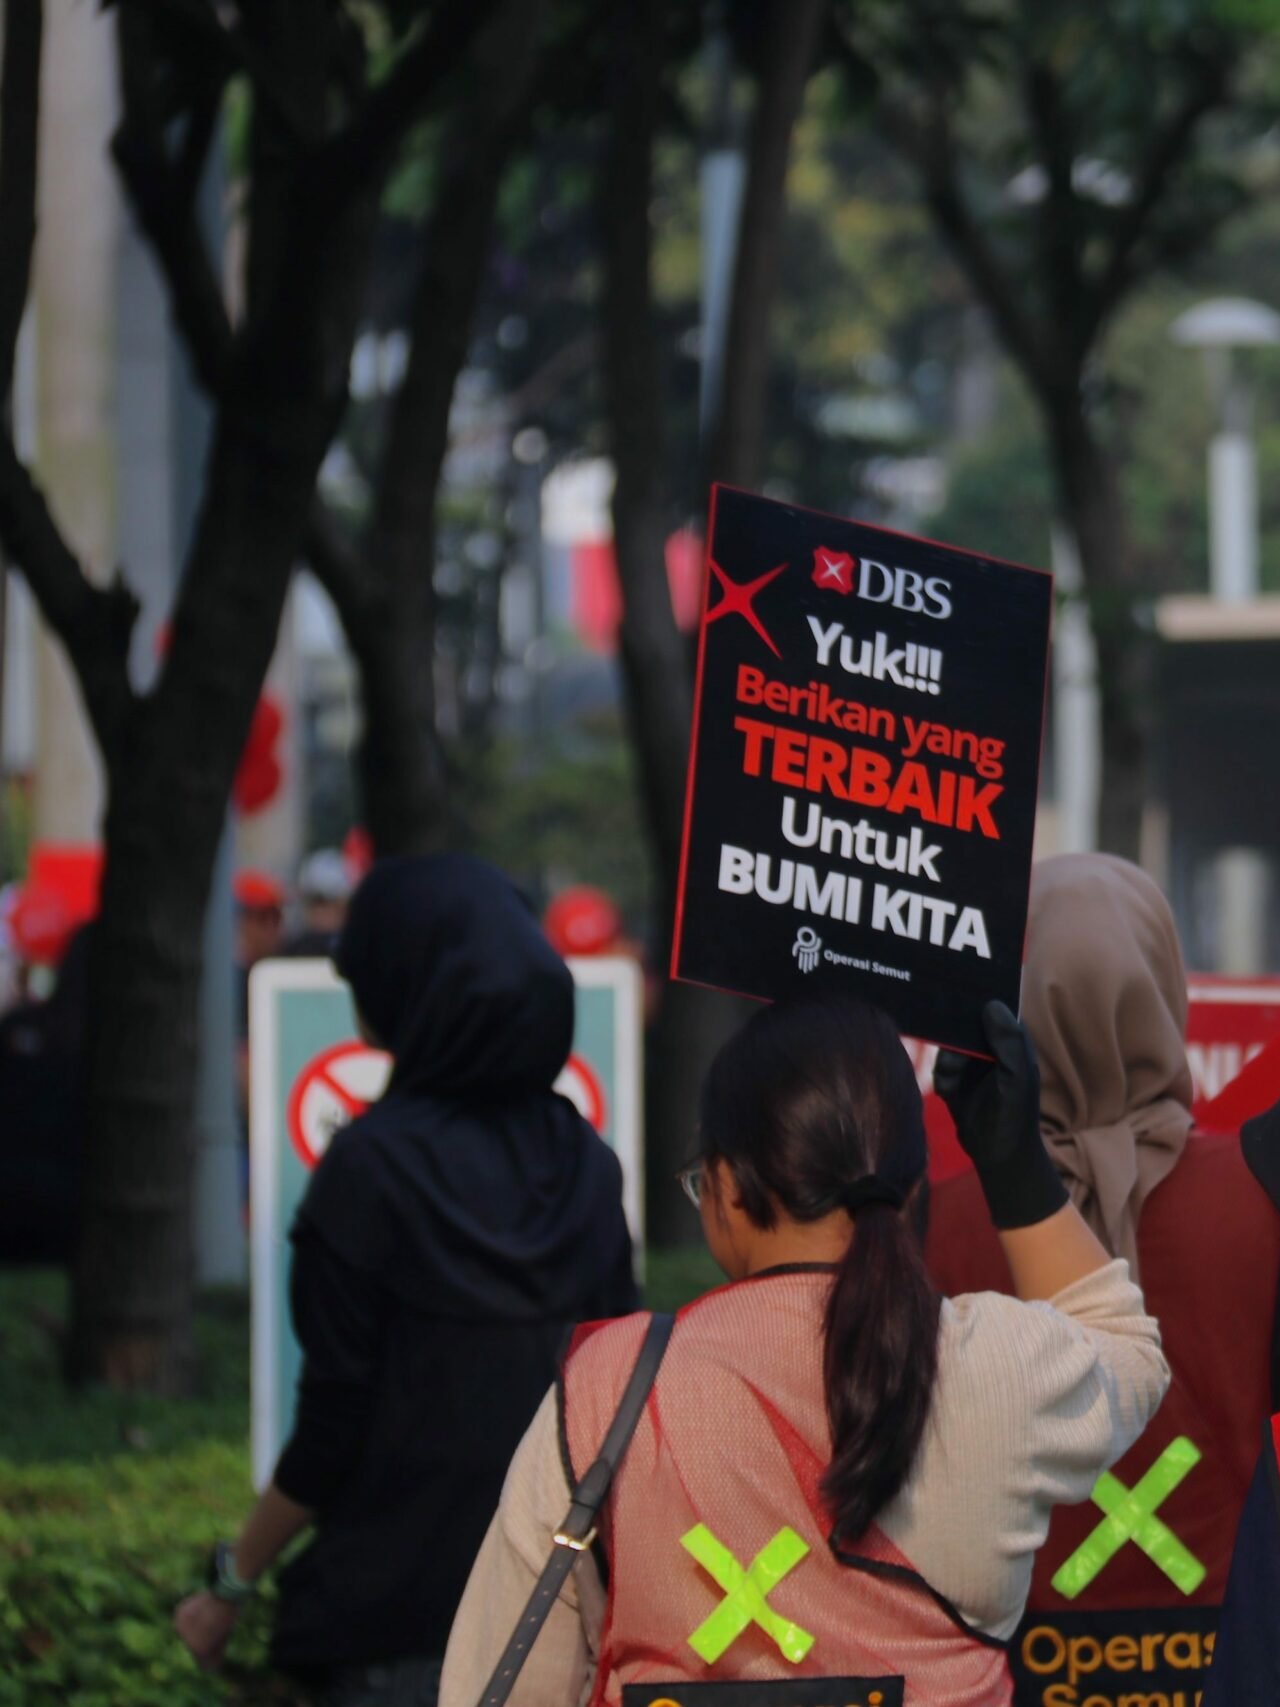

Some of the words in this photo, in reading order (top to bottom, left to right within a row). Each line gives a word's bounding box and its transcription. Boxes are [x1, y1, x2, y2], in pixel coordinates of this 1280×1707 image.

[857, 557, 952, 620] DBS
[806, 615, 942, 695] Yuk!!!
[736, 663, 895, 741] Berikan
[902, 716, 1005, 779] yang
[734, 715, 1004, 840] TERBAIK
[781, 796, 942, 883] Untuk
[717, 844, 862, 924] BUMI
[871, 883, 992, 960] KITA
[824, 949, 870, 972] Operasi
[872, 961, 911, 982] Semut
